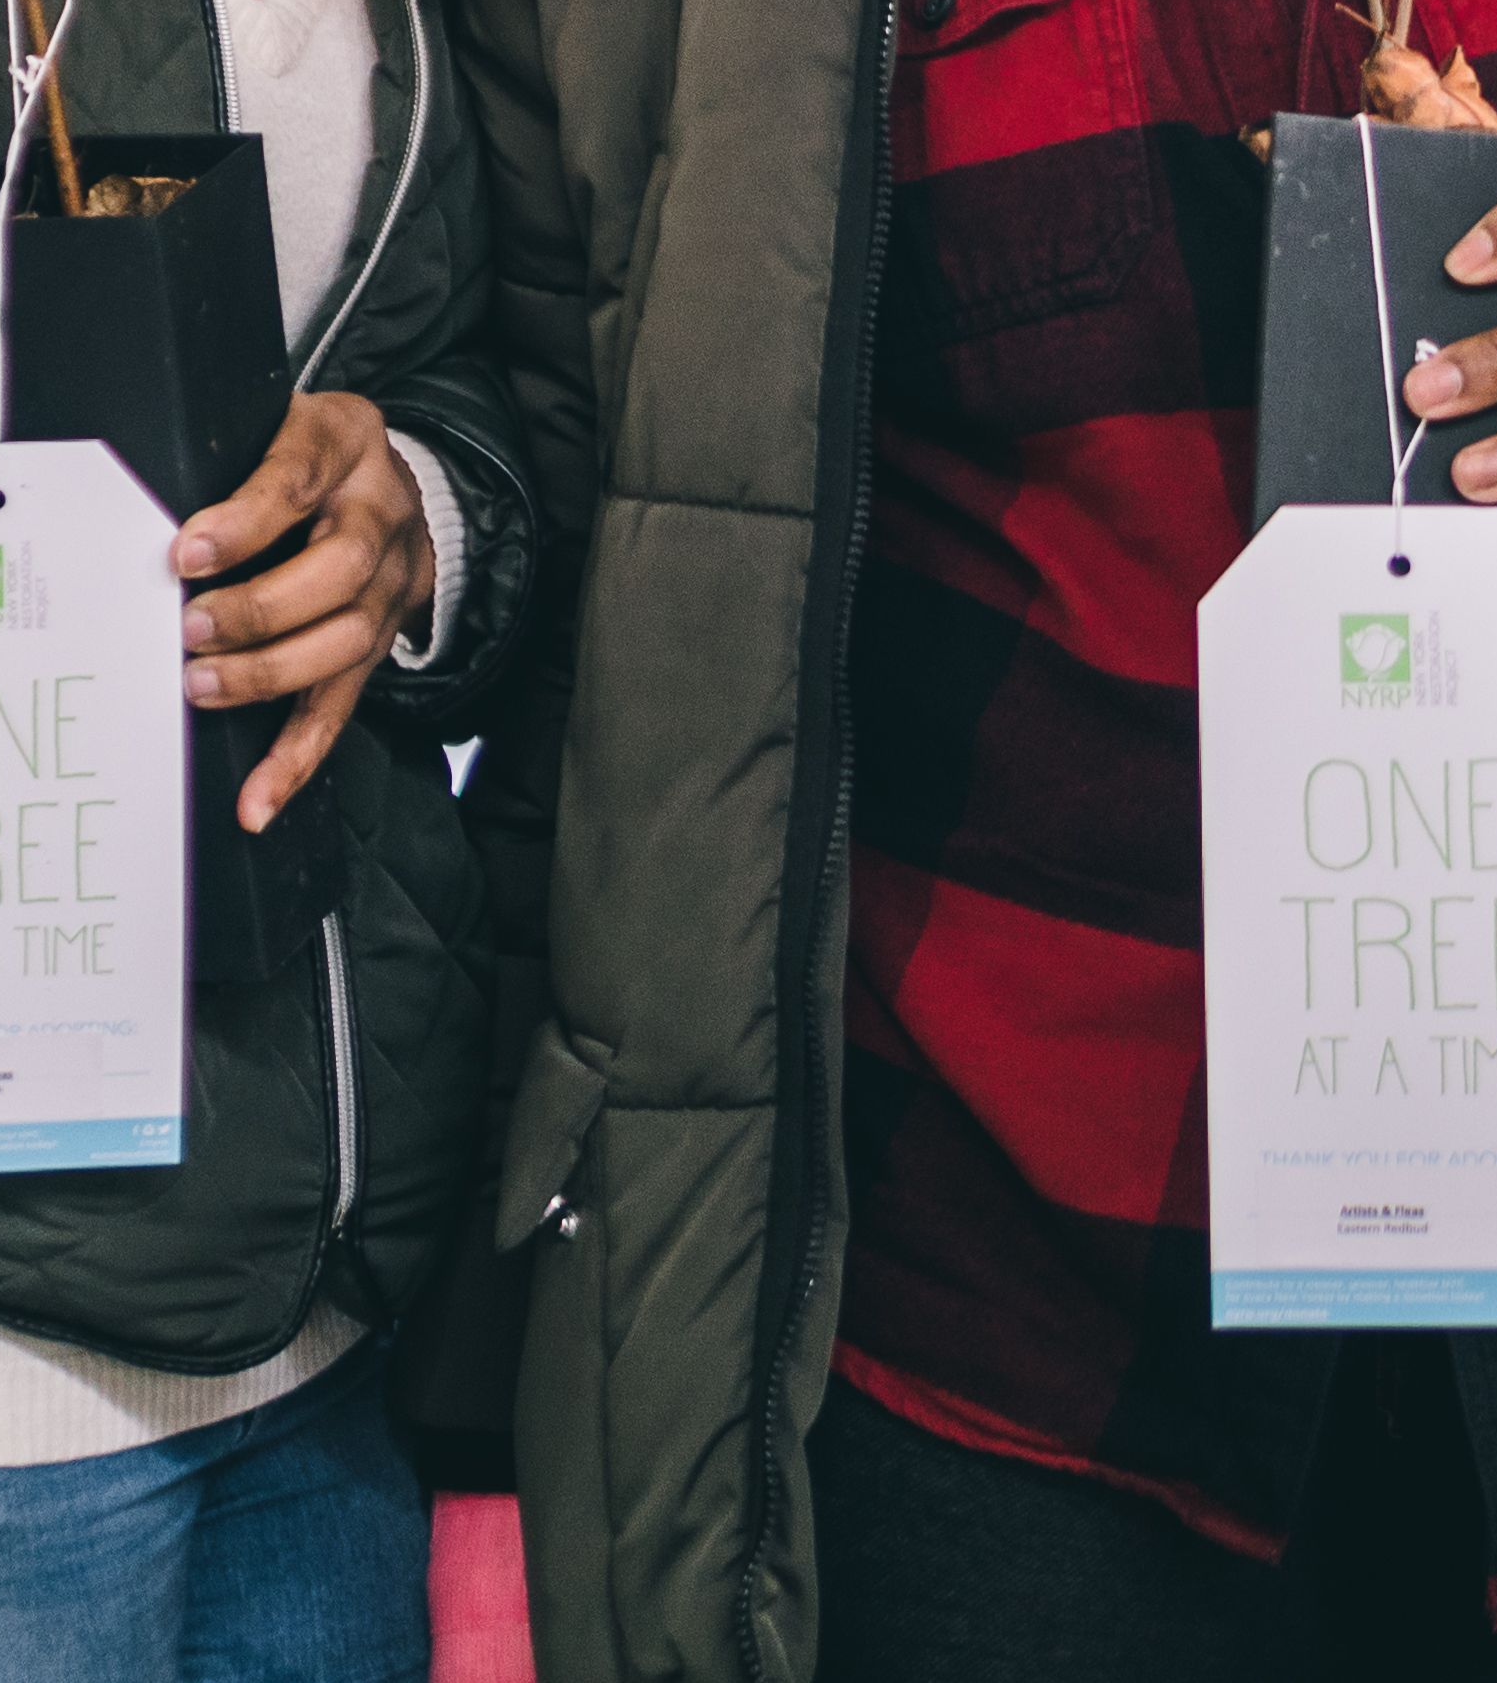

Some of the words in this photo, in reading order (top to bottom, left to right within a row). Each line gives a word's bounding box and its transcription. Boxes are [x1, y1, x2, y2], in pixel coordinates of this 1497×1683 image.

[1341, 683, 1411, 708] NYRP
[14, 922, 115, 978] TIME
[1295, 1036, 1349, 1096] AT
[1374, 1036, 1409, 1096] A
[1261, 1149, 1335, 1166] THANK
[1340, 1203, 1379, 1219] Artists
[1381, 1204, 1392, 1218] &
[1336, 1221, 1380, 1235] Eastern
